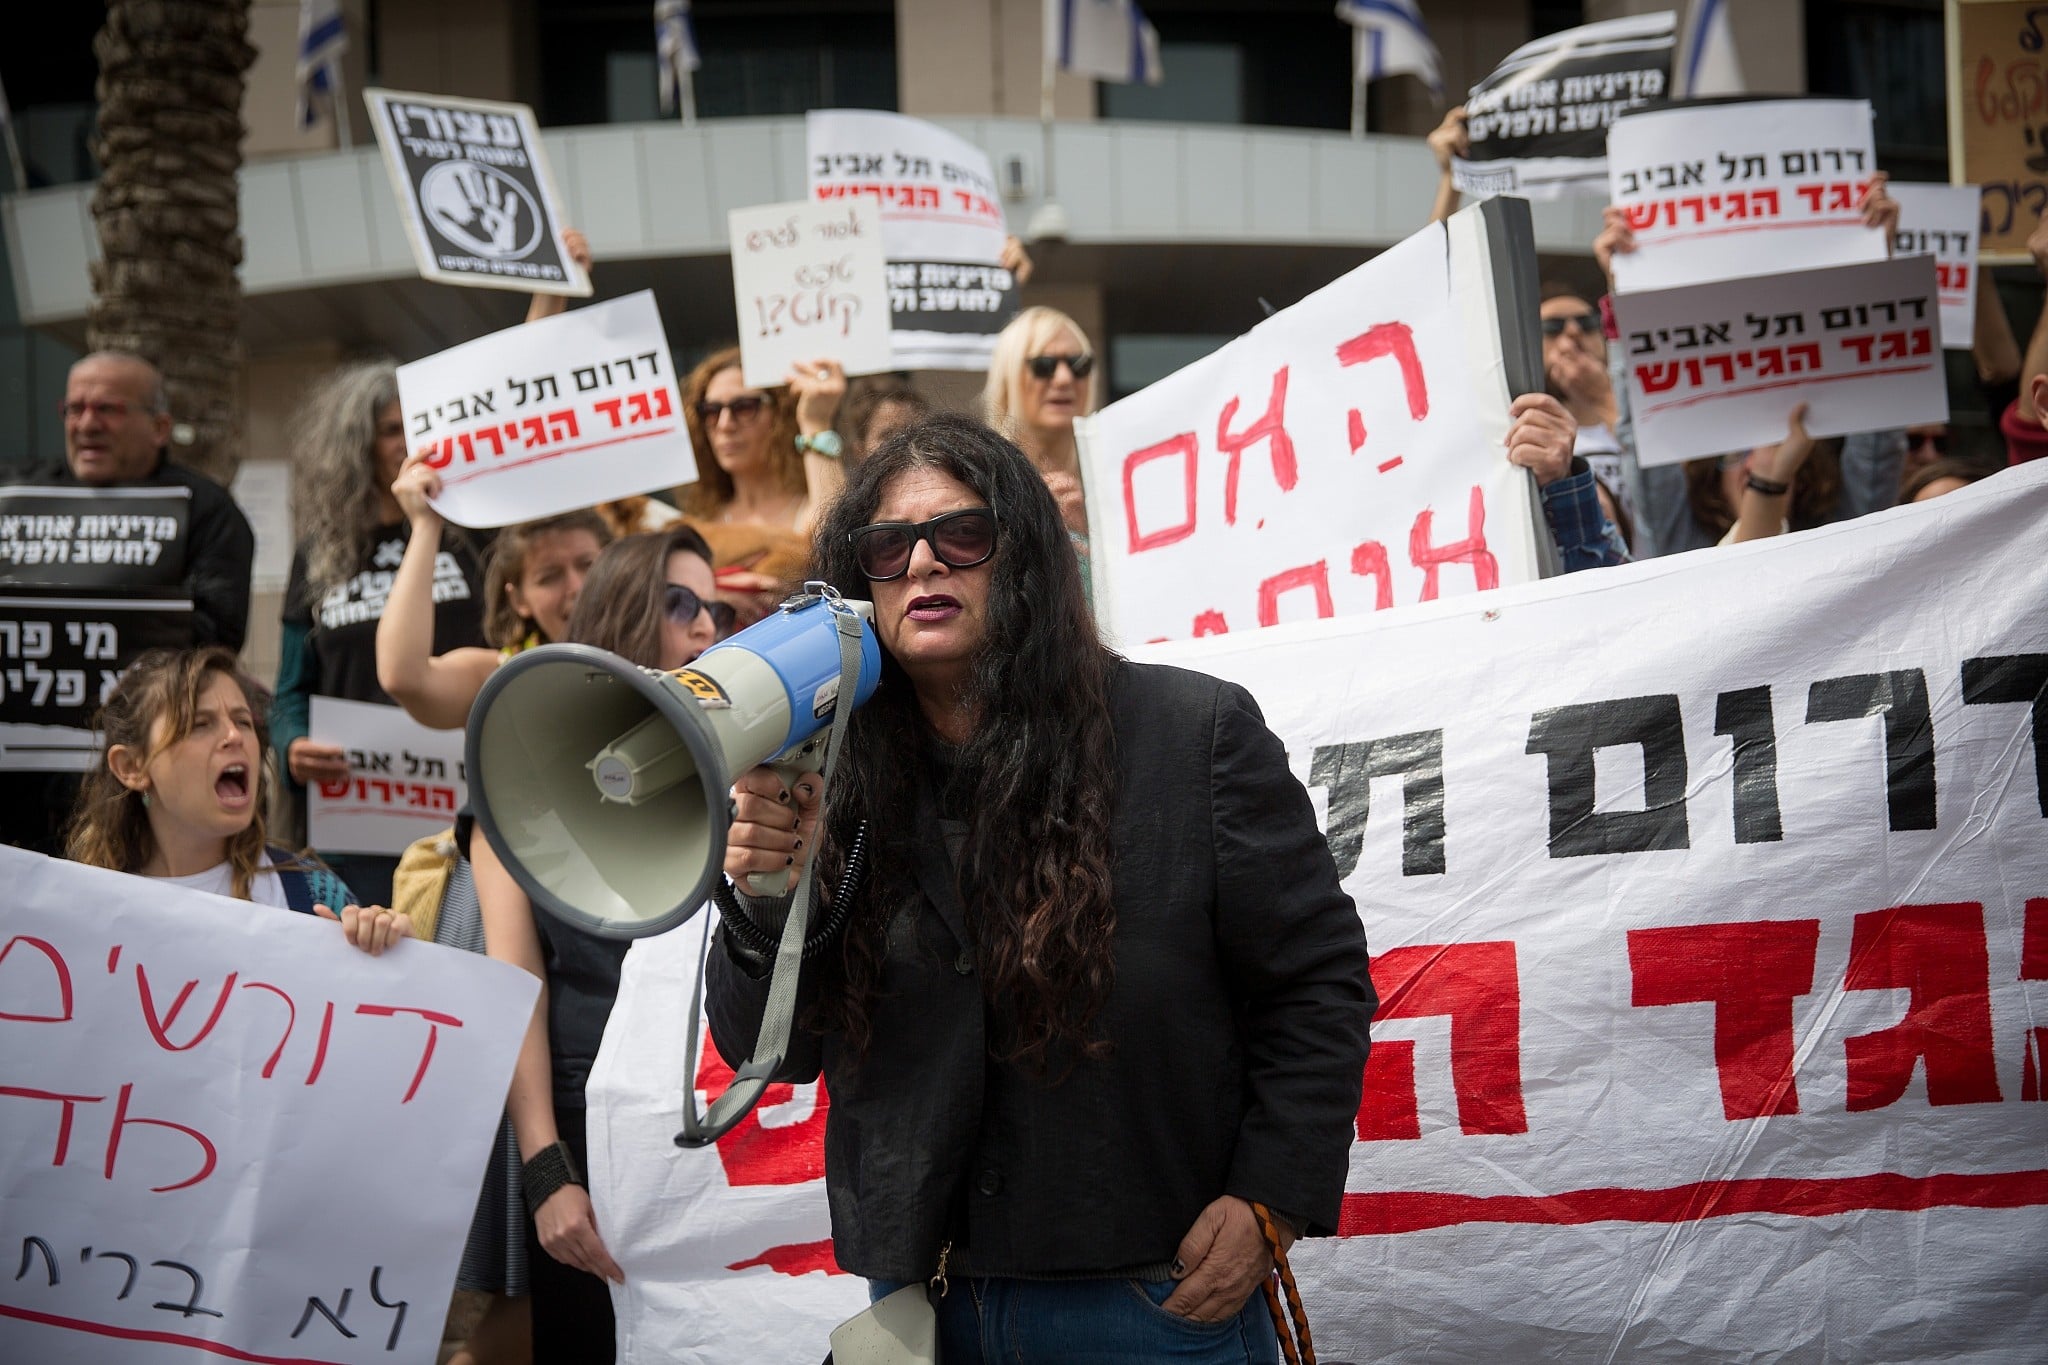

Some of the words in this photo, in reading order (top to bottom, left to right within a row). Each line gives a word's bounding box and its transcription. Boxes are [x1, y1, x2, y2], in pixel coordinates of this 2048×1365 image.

[816, 154, 882, 176] אביב
[893, 152, 930, 176] תל
[1620, 160, 1704, 195] אביב
[1719, 151, 1767, 181] תל
[1781, 149, 1866, 175] דרום
[1623, 186, 1781, 230] הגירוש
[1896, 229, 1968, 254] דרום
[1745, 312, 1805, 340] תל
[1820, 296, 1928, 330] דרום
[1630, 322, 1731, 355] אביב
[1841, 327, 1933, 364] נגד
[572, 350, 659, 393] דרום
[1635, 341, 1821, 395] הגירוש
[508, 375, 559, 407] תל
[594, 387, 673, 429] נגד
[411, 390, 497, 436] אביב
[419, 409, 580, 471] הגירוש
[65, 621, 119, 660] מי
[0, 661, 86, 707] פלי
[403, 750, 446, 778] תל
[1525, 652, 2048, 860] דרום
[318, 776, 457, 811] הגירוש
[1286, 728, 1447, 881] ת
[290, 1266, 408, 1351] לא
